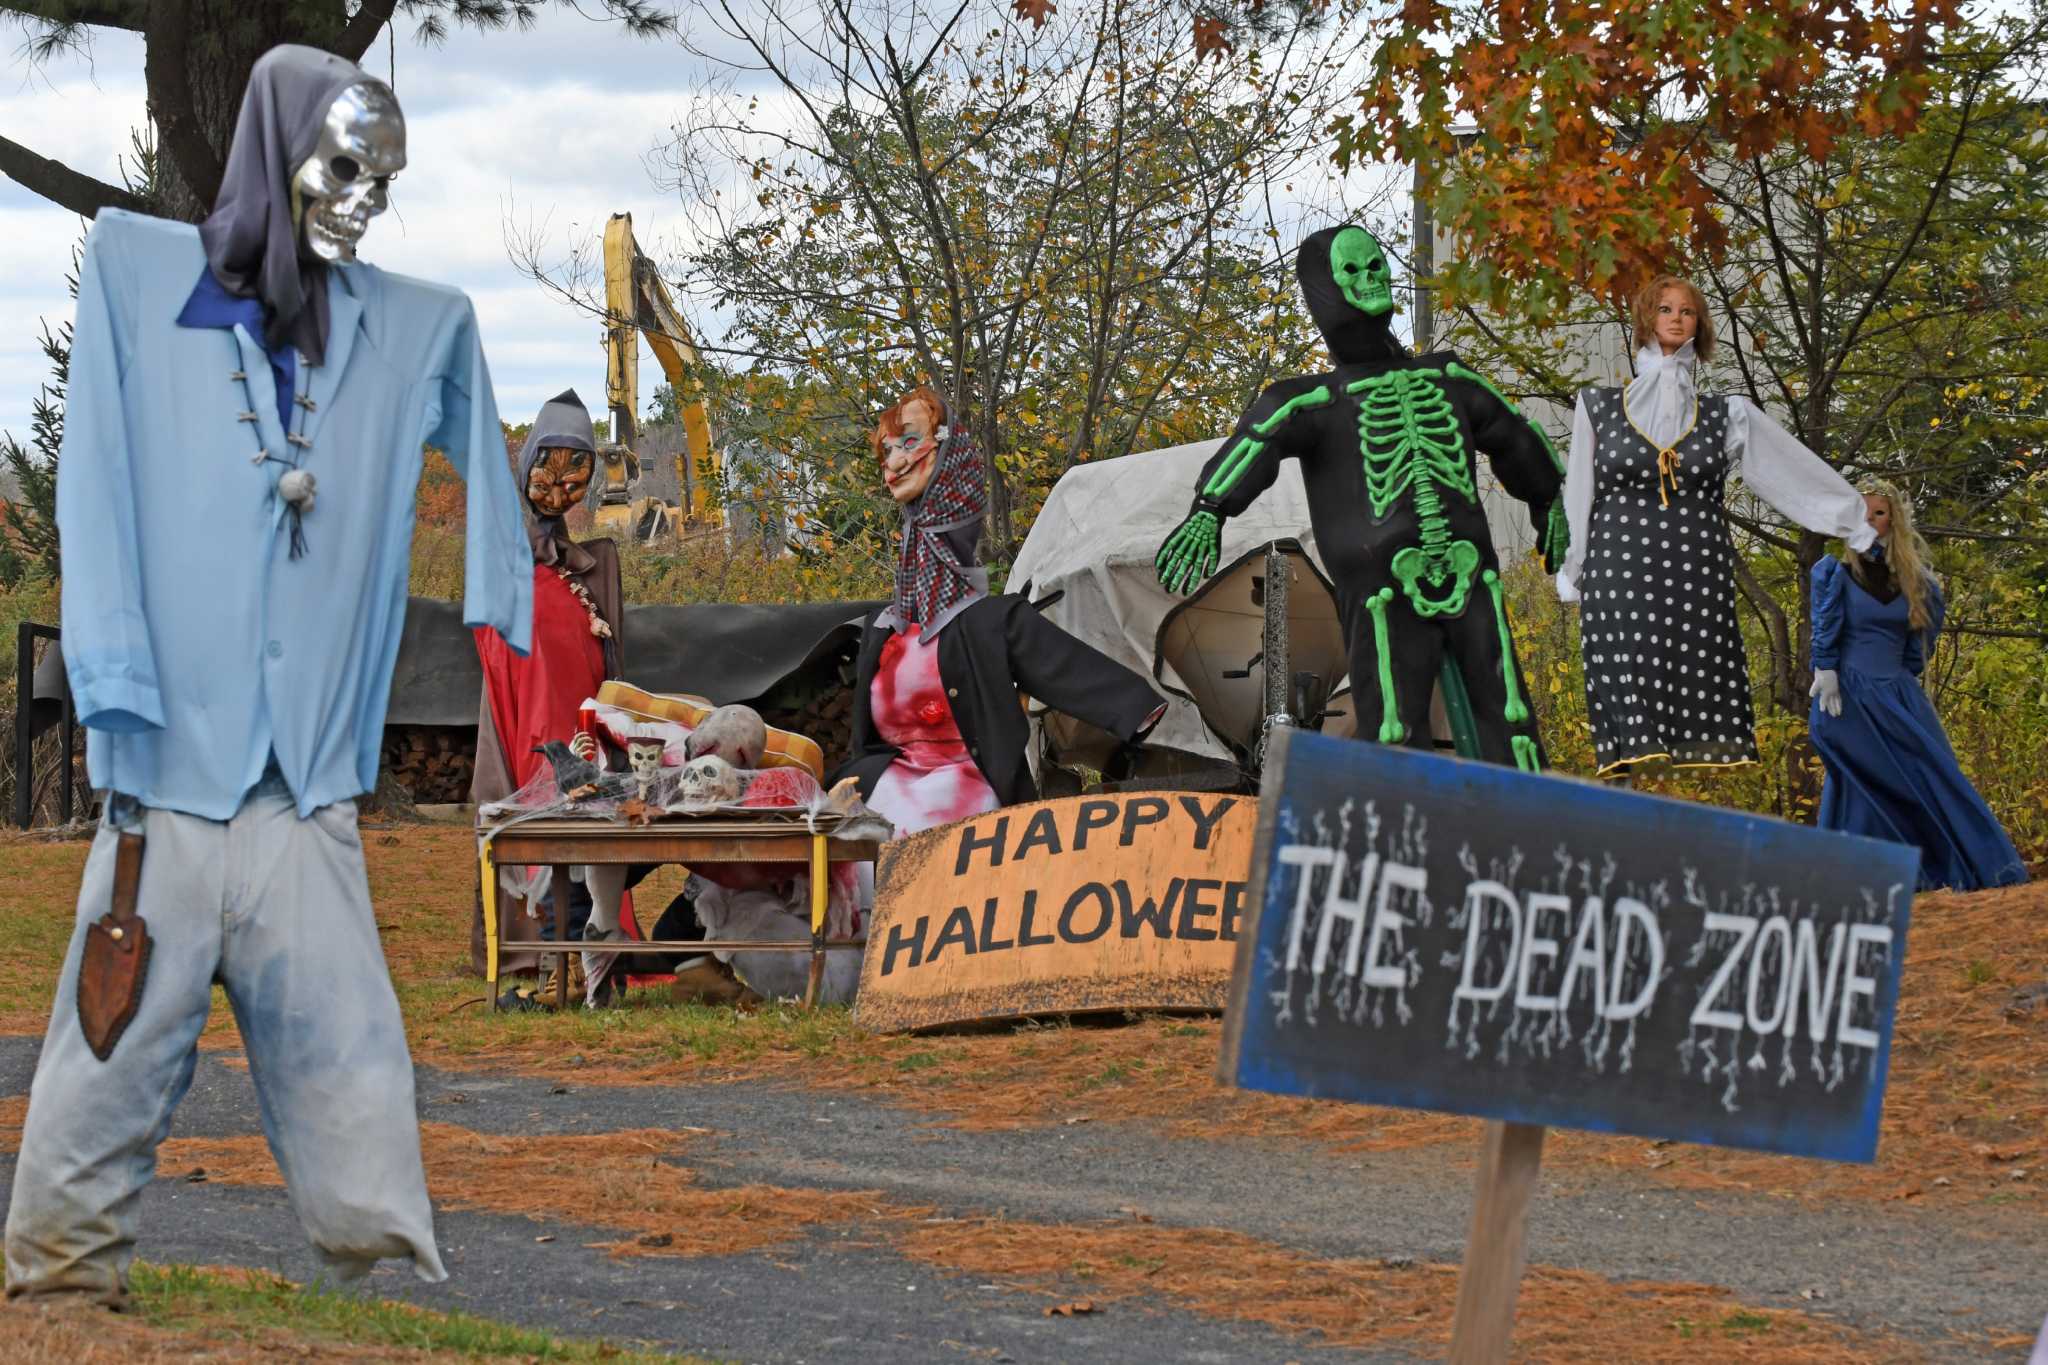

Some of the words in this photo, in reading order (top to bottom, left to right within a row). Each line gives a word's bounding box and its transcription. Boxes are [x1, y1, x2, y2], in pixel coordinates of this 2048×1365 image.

[954, 797, 1237, 877] HAPPY
[880, 876, 1248, 977] HALLOWEE
[1278, 844, 1428, 988] THE
[1454, 880, 1666, 1022] DEAD
[1691, 913, 1893, 1049] ZONE
